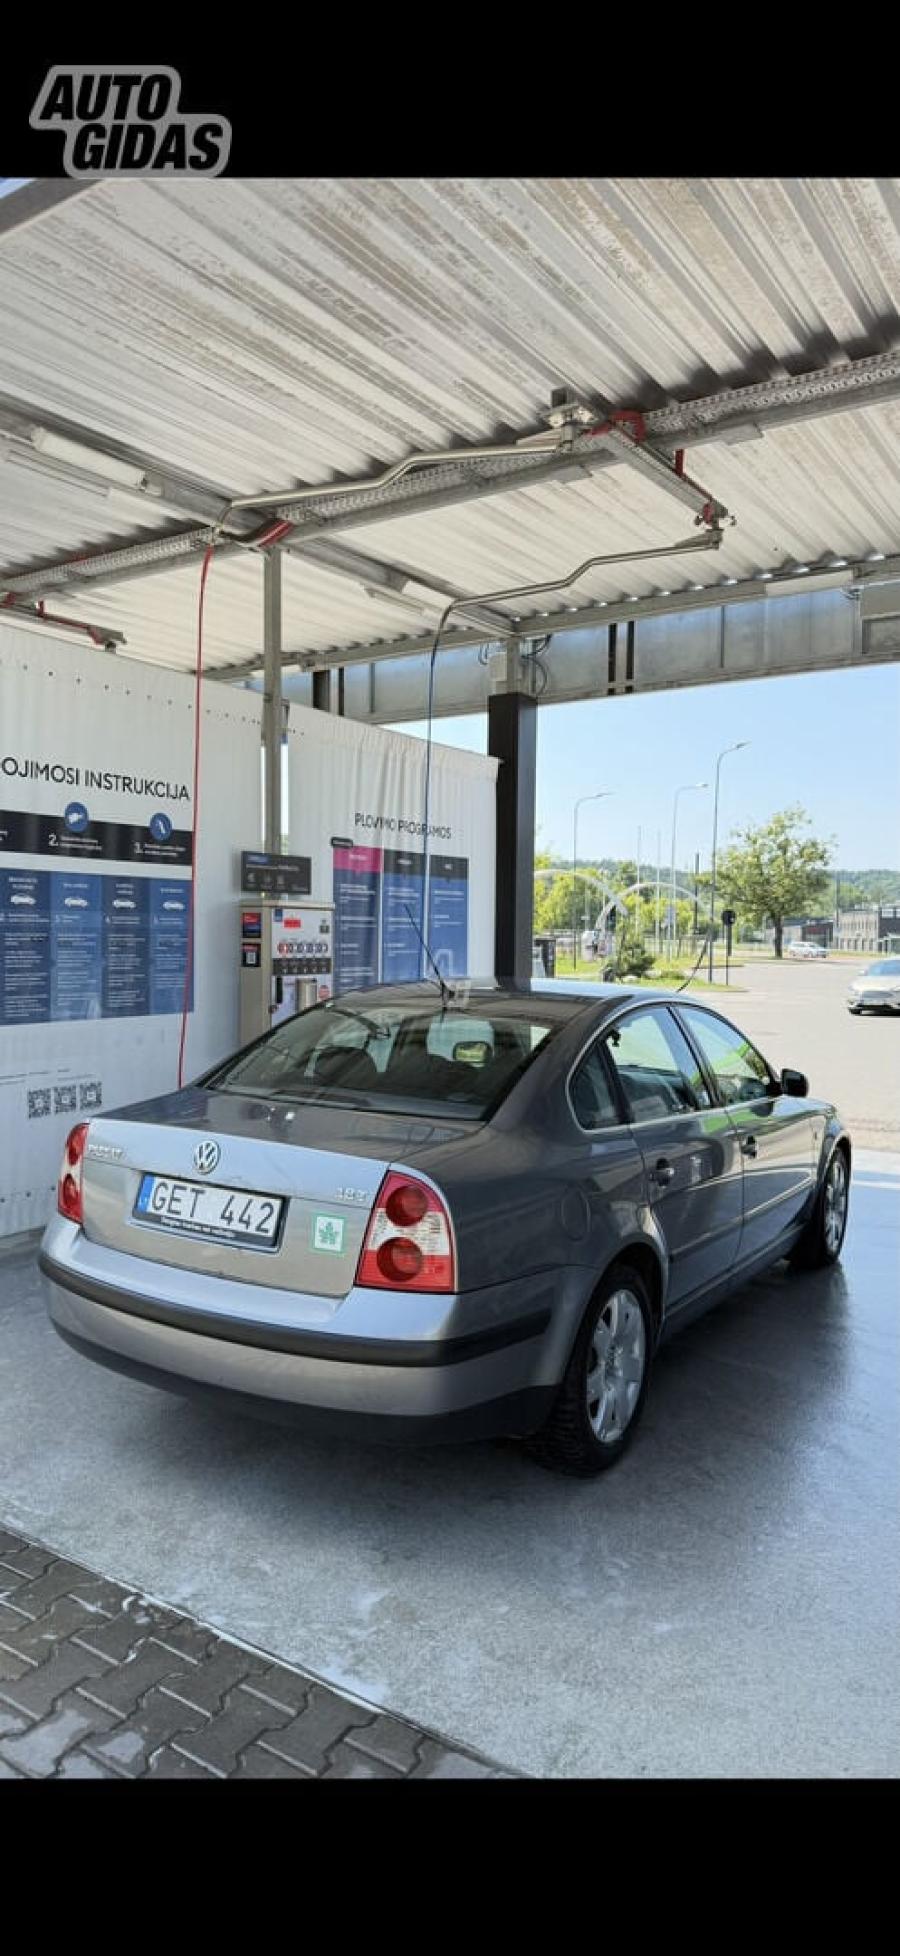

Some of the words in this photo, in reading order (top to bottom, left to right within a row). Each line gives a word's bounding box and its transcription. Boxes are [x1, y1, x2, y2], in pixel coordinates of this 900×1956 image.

[0, 756, 80, 786] OJIMOSI
[85, 769, 190, 801] INSTRUKCIJA
[151, 1181, 206, 1218] GET
[220, 1194, 275, 1234] 442
